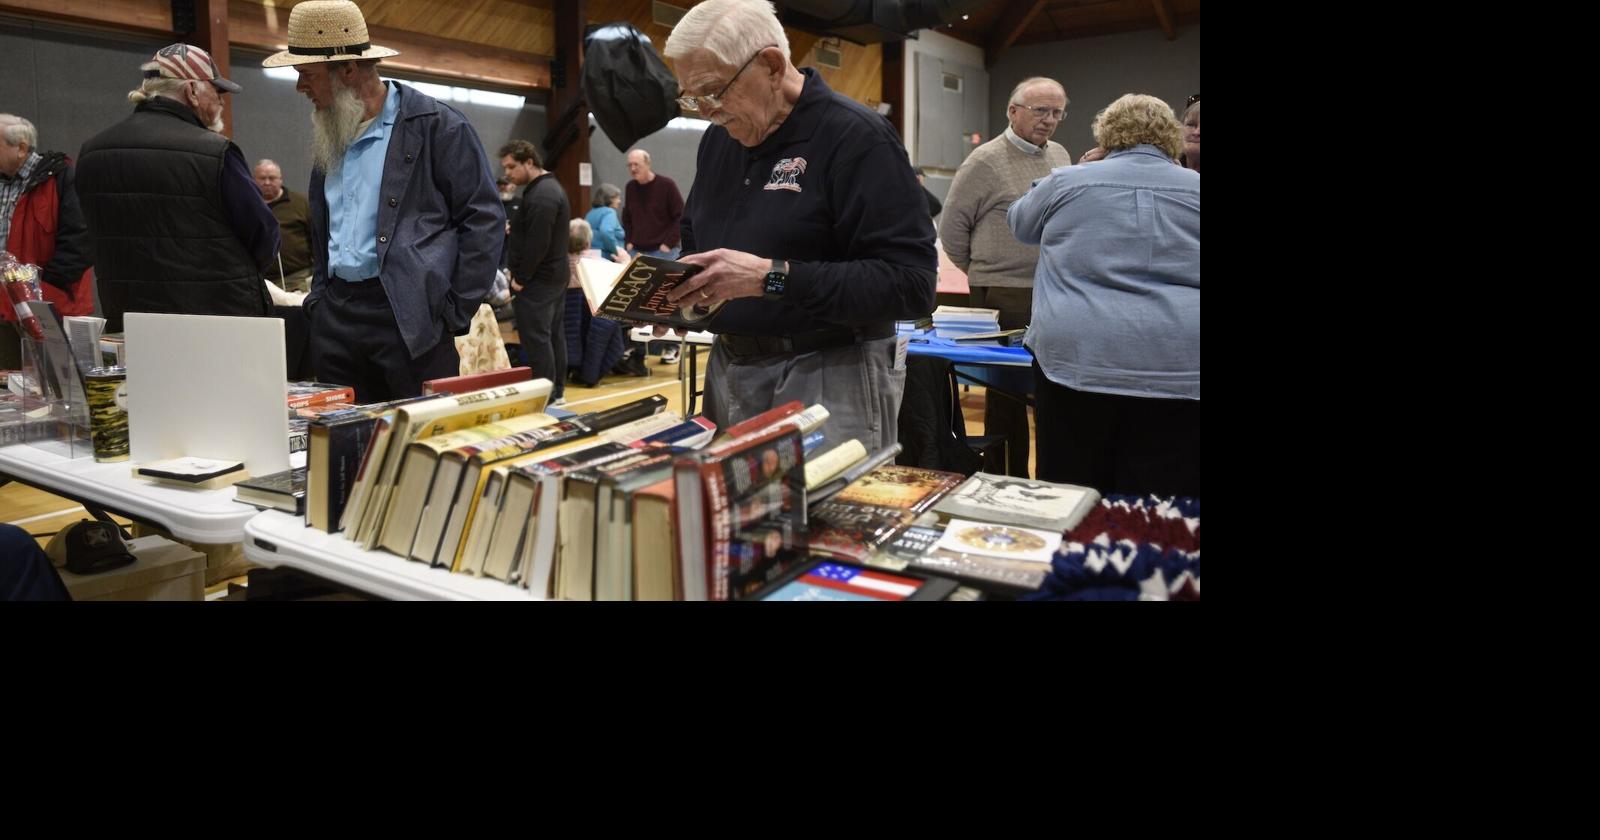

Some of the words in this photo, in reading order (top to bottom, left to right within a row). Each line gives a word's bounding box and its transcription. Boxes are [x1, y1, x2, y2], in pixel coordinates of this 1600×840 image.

[605, 260, 657, 313] LEGACY
[640, 279, 676, 312] James
[289, 435, 301, 454] THE
